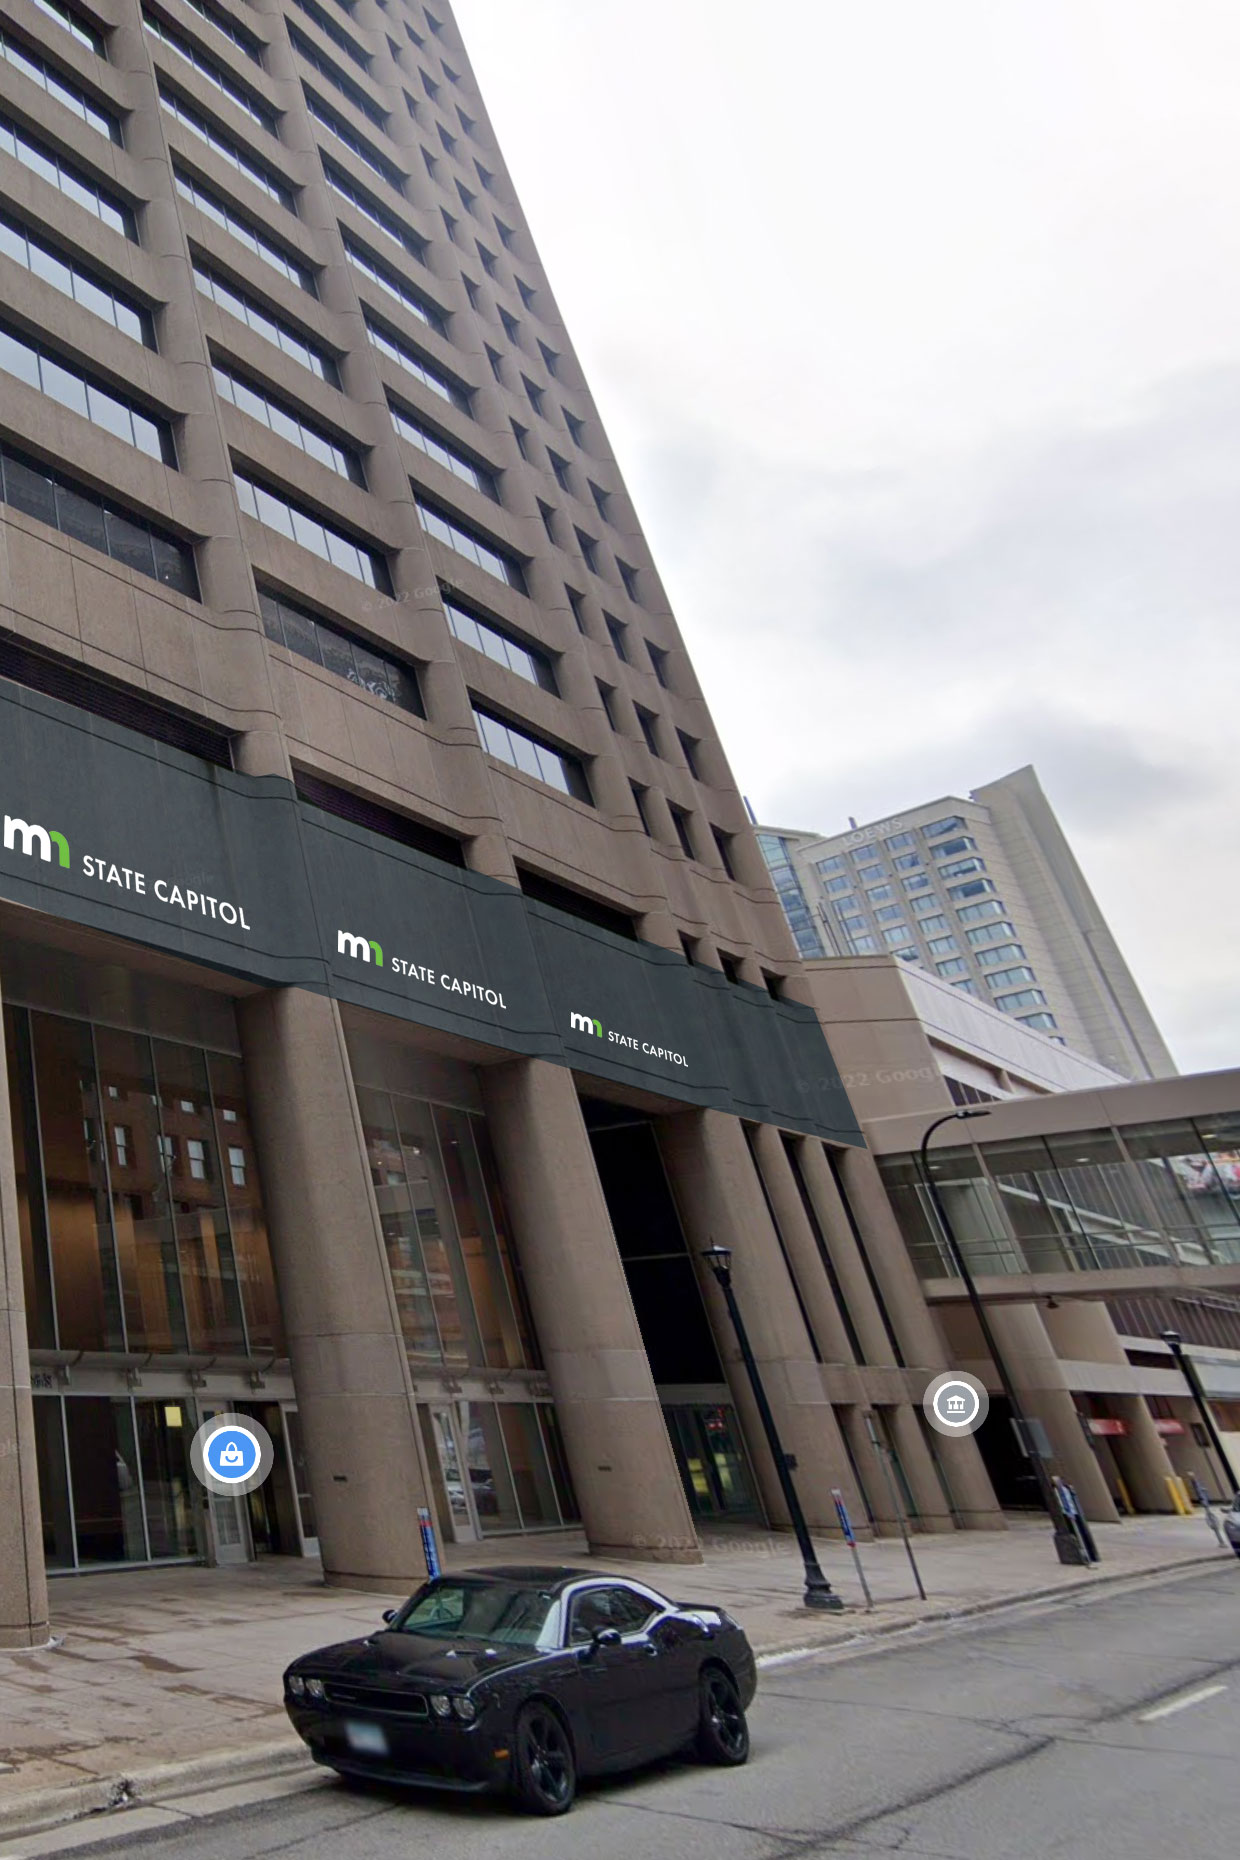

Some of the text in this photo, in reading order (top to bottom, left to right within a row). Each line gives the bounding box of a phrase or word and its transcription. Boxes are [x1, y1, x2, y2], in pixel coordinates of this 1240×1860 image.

[842, 818, 903, 848] LOEWS
[82, 855, 146, 895] STATE
[154, 879, 251, 931] CAPITOL
[391, 957, 436, 985] STATE
[440, 974, 507, 1009] CAPITOL
[608, 1030, 639, 1051] STATE
[642, 1042, 689, 1068] CAPITOL
